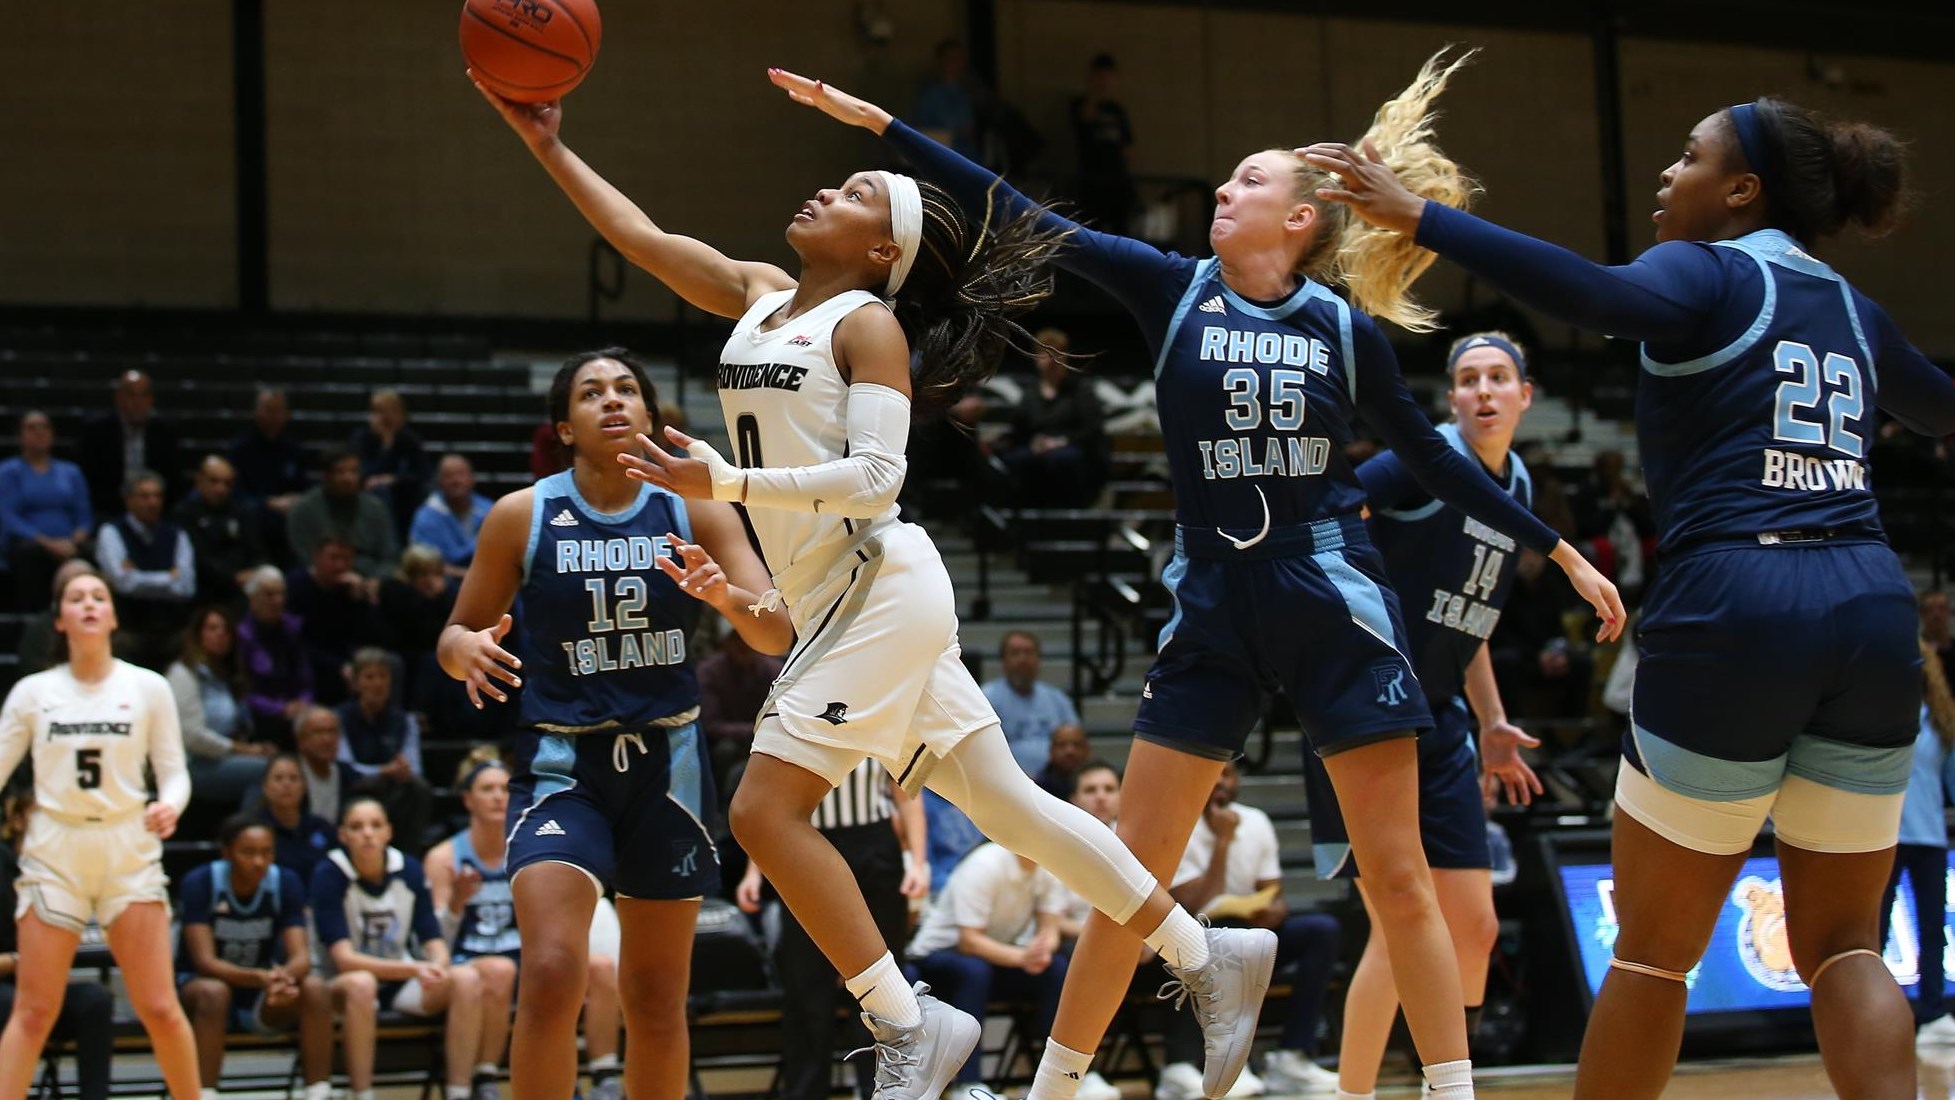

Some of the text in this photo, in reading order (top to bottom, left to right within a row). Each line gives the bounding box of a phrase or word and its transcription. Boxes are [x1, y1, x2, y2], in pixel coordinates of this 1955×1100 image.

[1200, 326, 1331, 376] RHODE
[717, 363, 810, 392] ROVIDENCE
[1223, 368, 1306, 431] 35
[1773, 340, 1864, 459] 22
[1198, 437, 1331, 480] ISLAND
[556, 536, 673, 573] RHODE
[1463, 543, 1505, 601] 14
[585, 576, 650, 633] 12
[561, 628, 687, 676] ISLAND
[75, 748, 103, 790] 5
